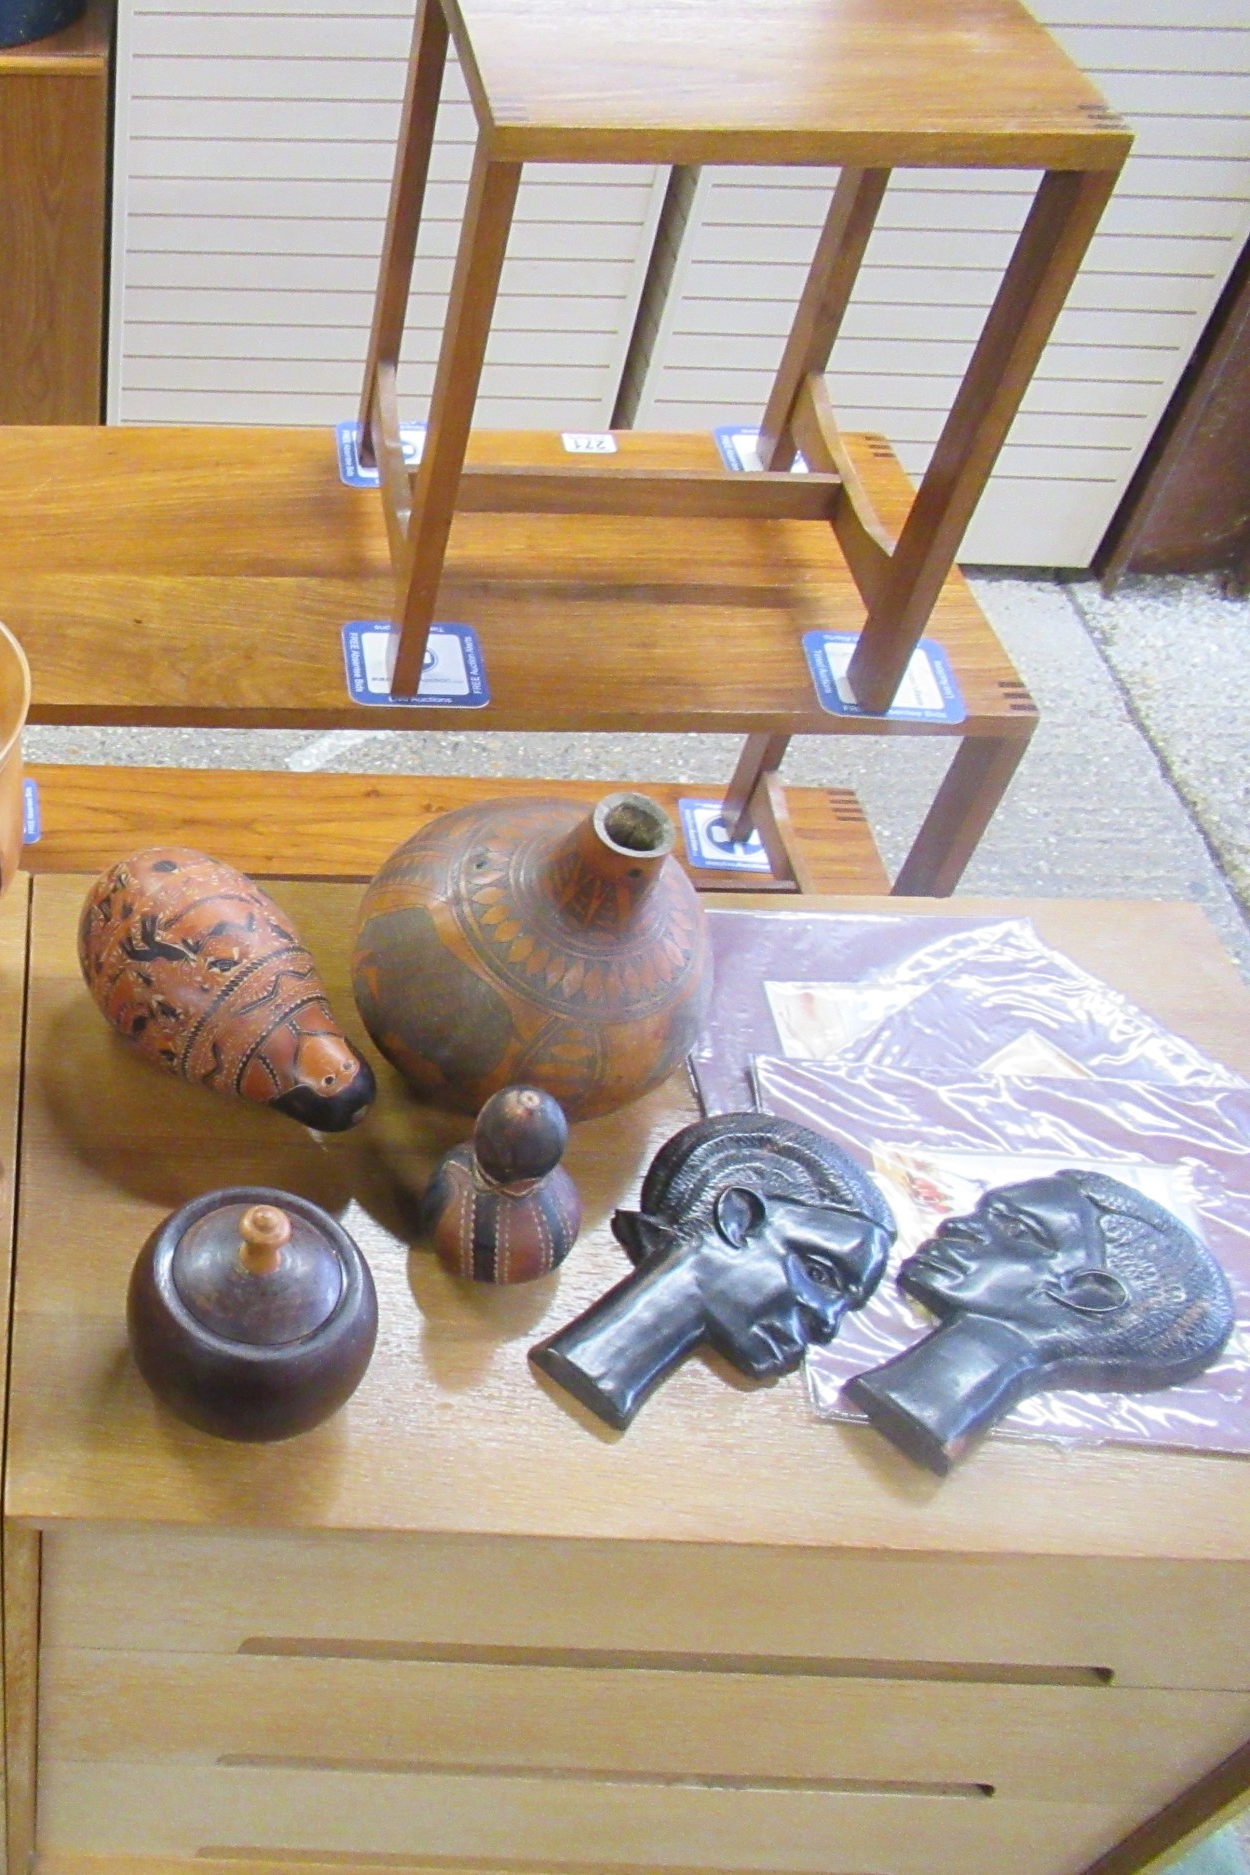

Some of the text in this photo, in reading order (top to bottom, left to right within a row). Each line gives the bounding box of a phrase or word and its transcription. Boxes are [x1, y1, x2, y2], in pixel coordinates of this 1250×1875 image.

[574, 439, 606, 450] 271
[349, 632, 360, 649] FREE
[467, 654, 479, 675] Auction
[470, 676, 482, 694] FREE
